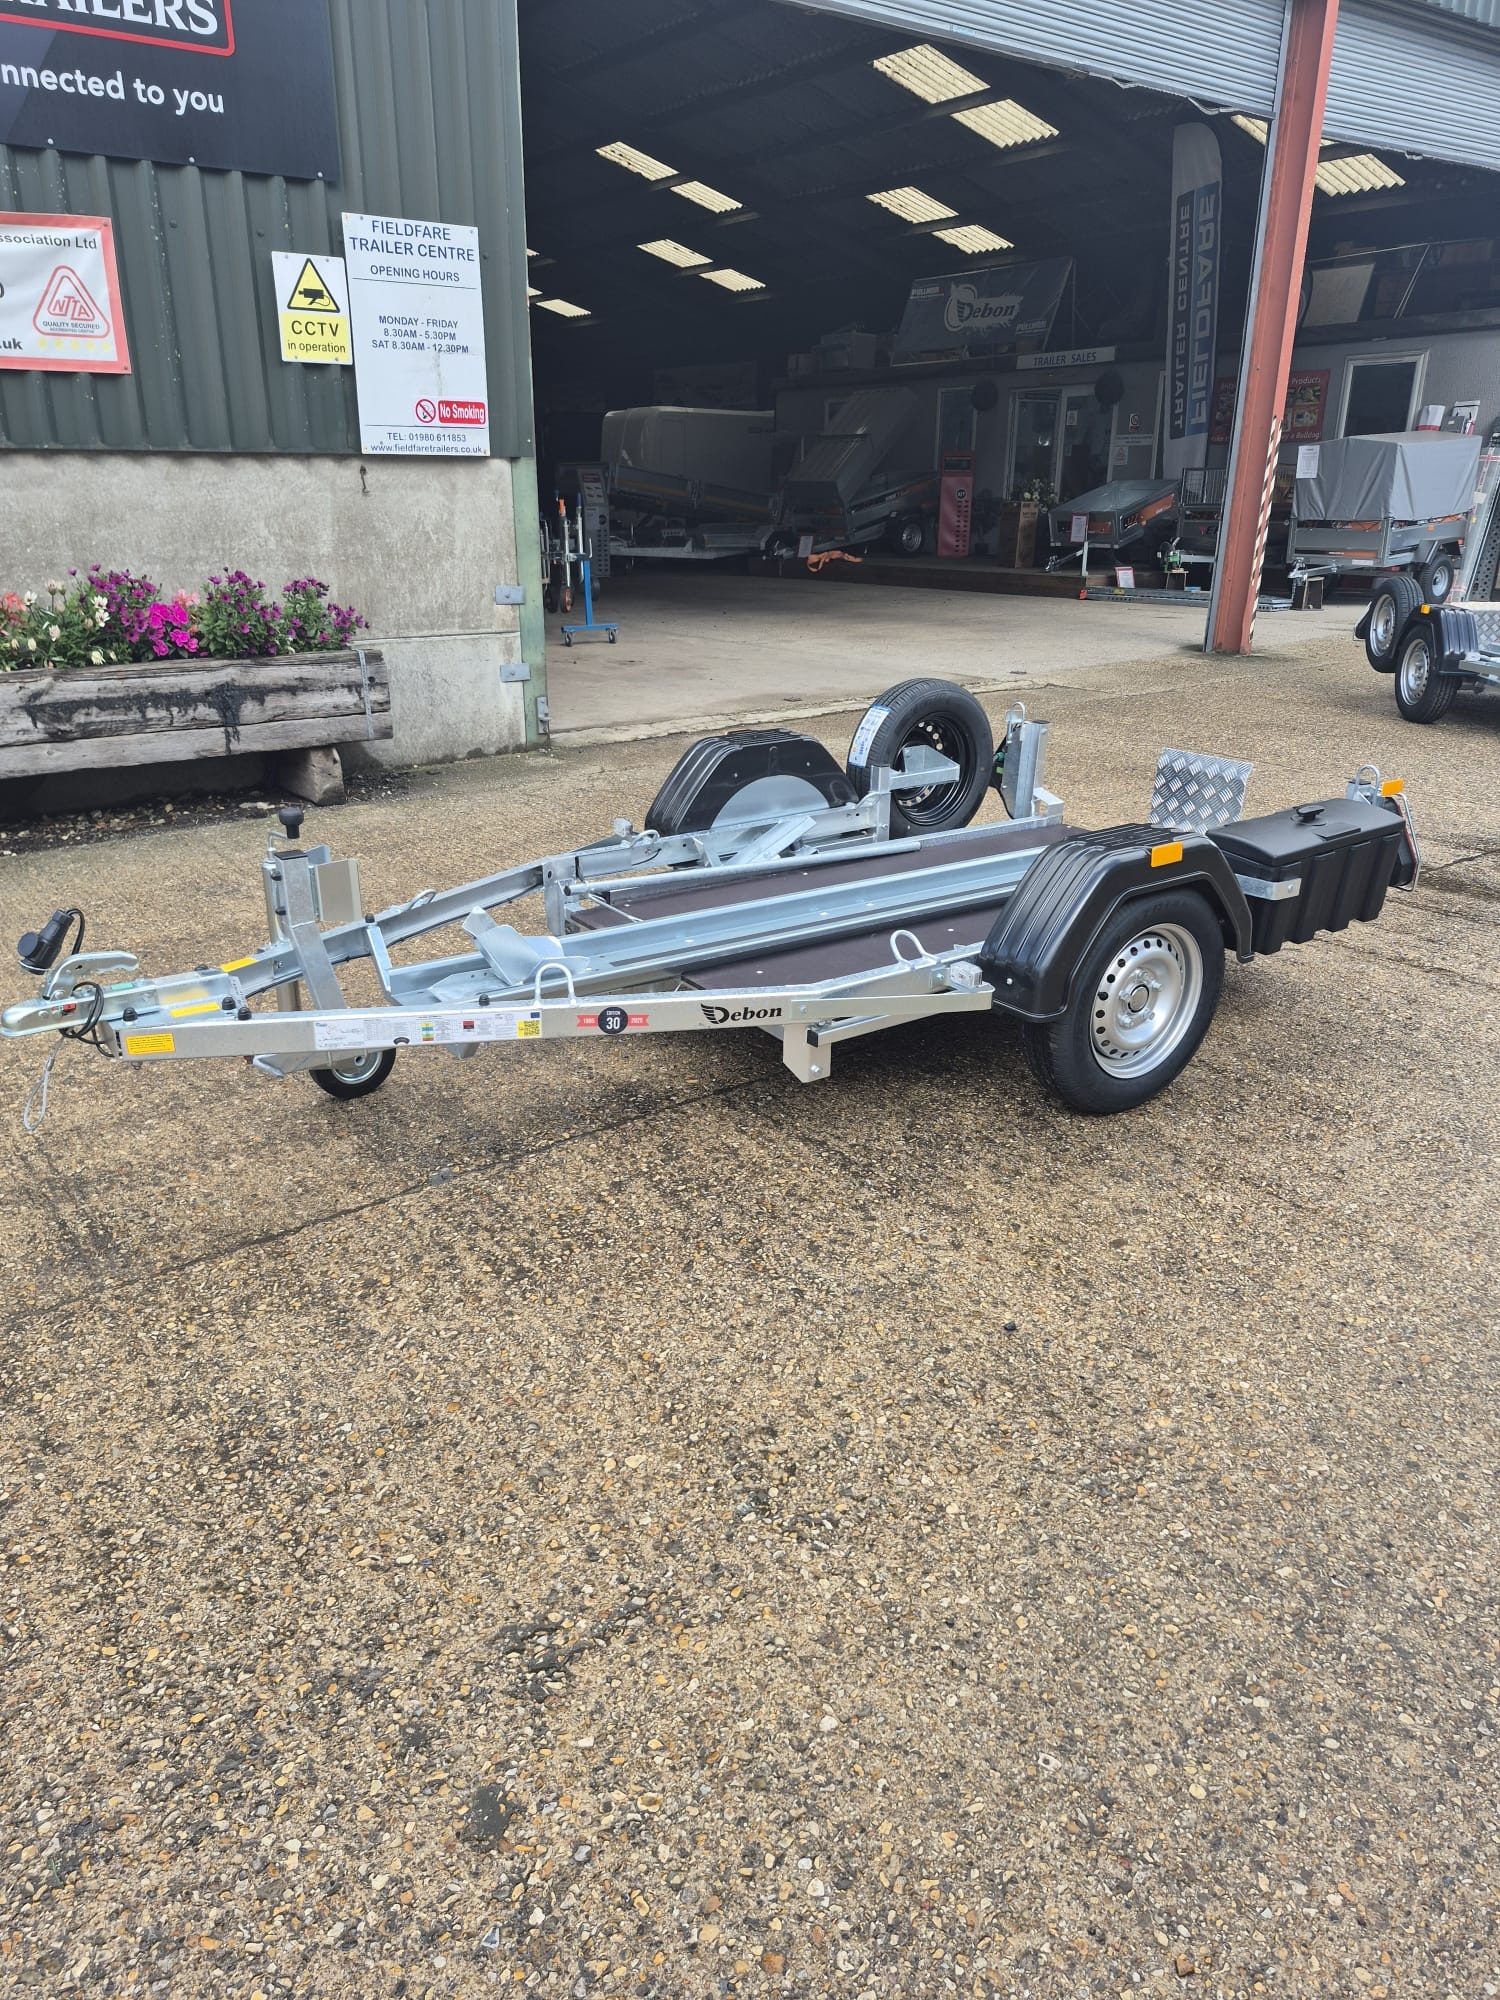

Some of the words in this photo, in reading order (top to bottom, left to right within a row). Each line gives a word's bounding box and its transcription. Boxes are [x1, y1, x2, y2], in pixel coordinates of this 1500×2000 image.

[1, 63, 125, 100] nnected
[133, 78, 165, 105] to
[173, 88, 224, 116] you
[372, 220, 451, 241] FIELDFARE
[75, 236, 97, 249] Ltd
[350, 237, 414, 256] TRAILER
[418, 244, 475, 261] CENTRE
[370, 265, 420, 279] OPENING
[423, 271, 460, 282] HOURS
[957, 300, 1016, 323] Debon
[42, 321, 69, 329] QUALITY
[291, 320, 339, 337] CCTV
[379, 315, 419, 327] MONDAY
[426, 319, 458, 329] FRIDAY
[384, 328, 417, 339] 8.30AM
[424, 331, 456, 341] 5.30PM
[287, 340, 297, 351] in
[299, 342, 346, 353] operation
[372, 340, 389, 350] SAT
[392, 341, 425, 351] 8.30AM
[433, 343, 469, 354] 12.30PM
[1033, 354, 1066, 368] TRAILER
[1071, 351, 1097, 363] SALES
[440, 404, 450, 418] No
[452, 403, 485, 423] Smoking
[387, 432, 407, 441] TEL:
[409, 433, 434, 442] 01980
[437, 434, 467, 442] 611853
[371, 443, 482, 454] www.fieldfaretrailers.co.uk
[701, 1003, 782, 1024] Debon
[606, 1016, 620, 1030] 30
